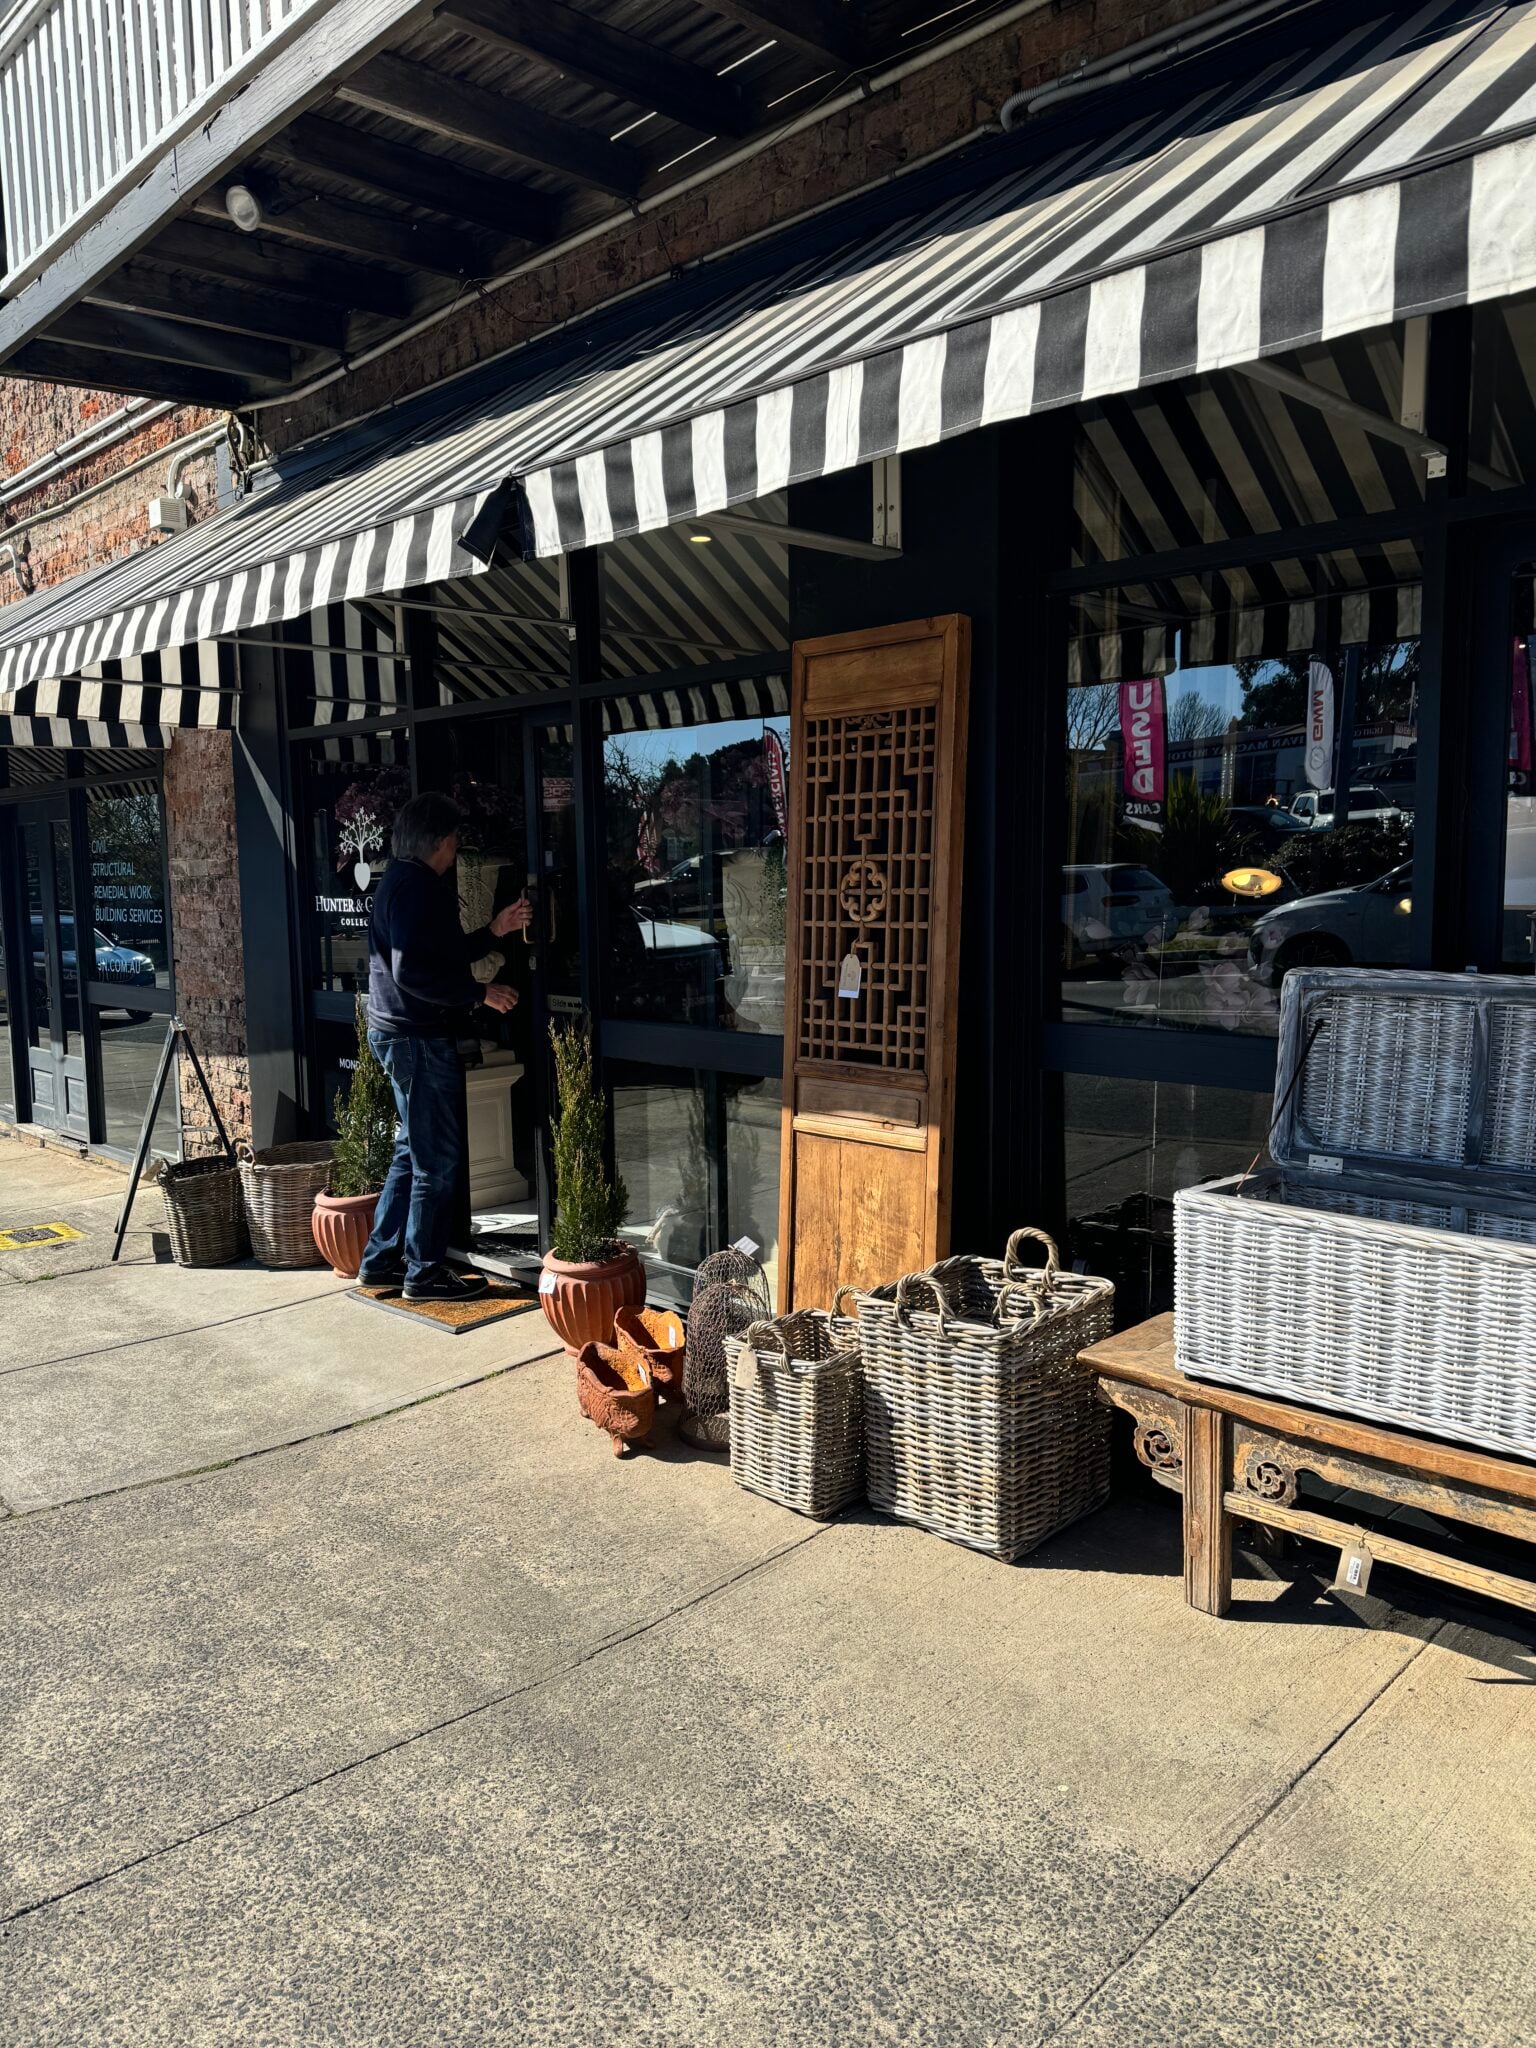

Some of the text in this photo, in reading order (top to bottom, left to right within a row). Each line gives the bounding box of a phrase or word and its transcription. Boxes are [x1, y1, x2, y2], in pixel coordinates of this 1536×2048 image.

[92, 863, 135, 876] STRUCTURAL
[94, 885, 152, 899] REMEDIAL WORK
[315, 895, 355, 912] HUNTER
[355, 898, 364, 913] &
[95, 907, 163, 924] BUILDING SERVICES
[340, 917, 369, 927] COLLEC
[339, 1057, 361, 1071] MOND
